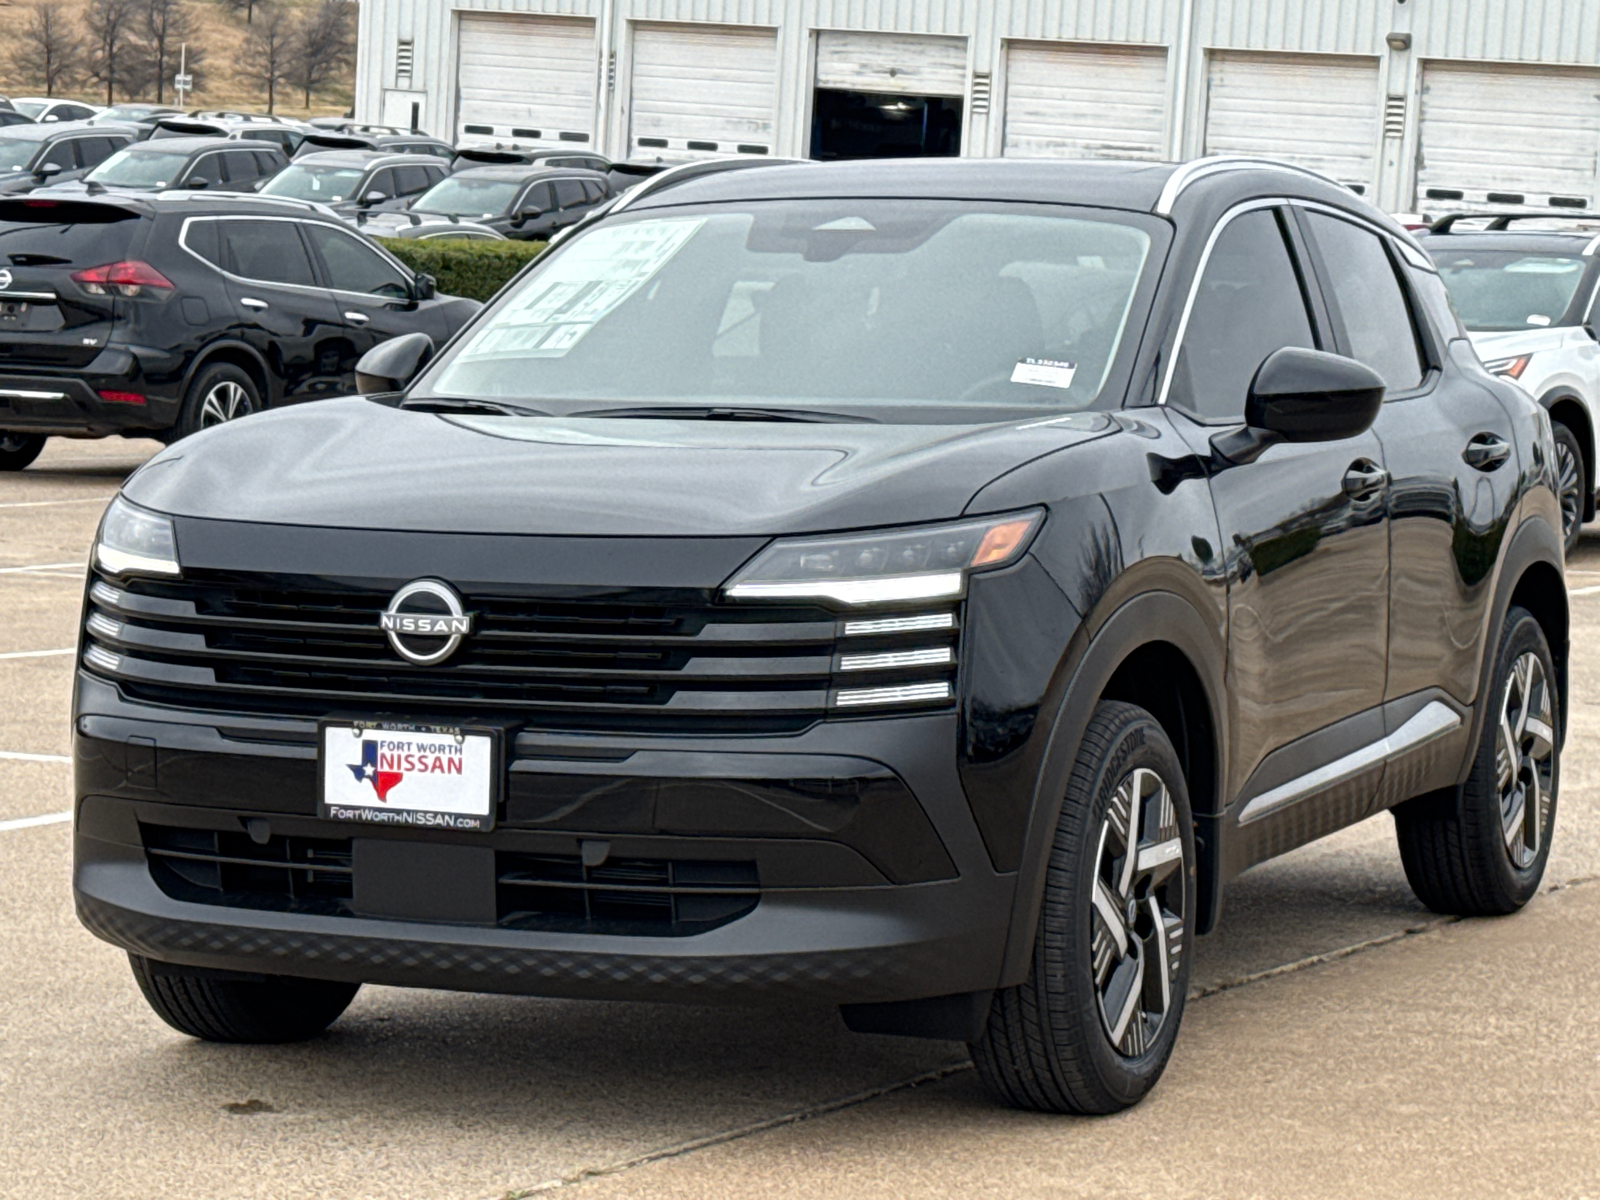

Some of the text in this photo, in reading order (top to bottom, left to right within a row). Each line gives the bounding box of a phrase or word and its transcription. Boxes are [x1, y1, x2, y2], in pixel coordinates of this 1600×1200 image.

[381, 615, 467, 633] NISSAN
[353, 721, 460, 735] FORT WORTH TEXAS
[380, 740, 463, 756] FORT WORTH
[380, 753, 463, 775] NISSAN
